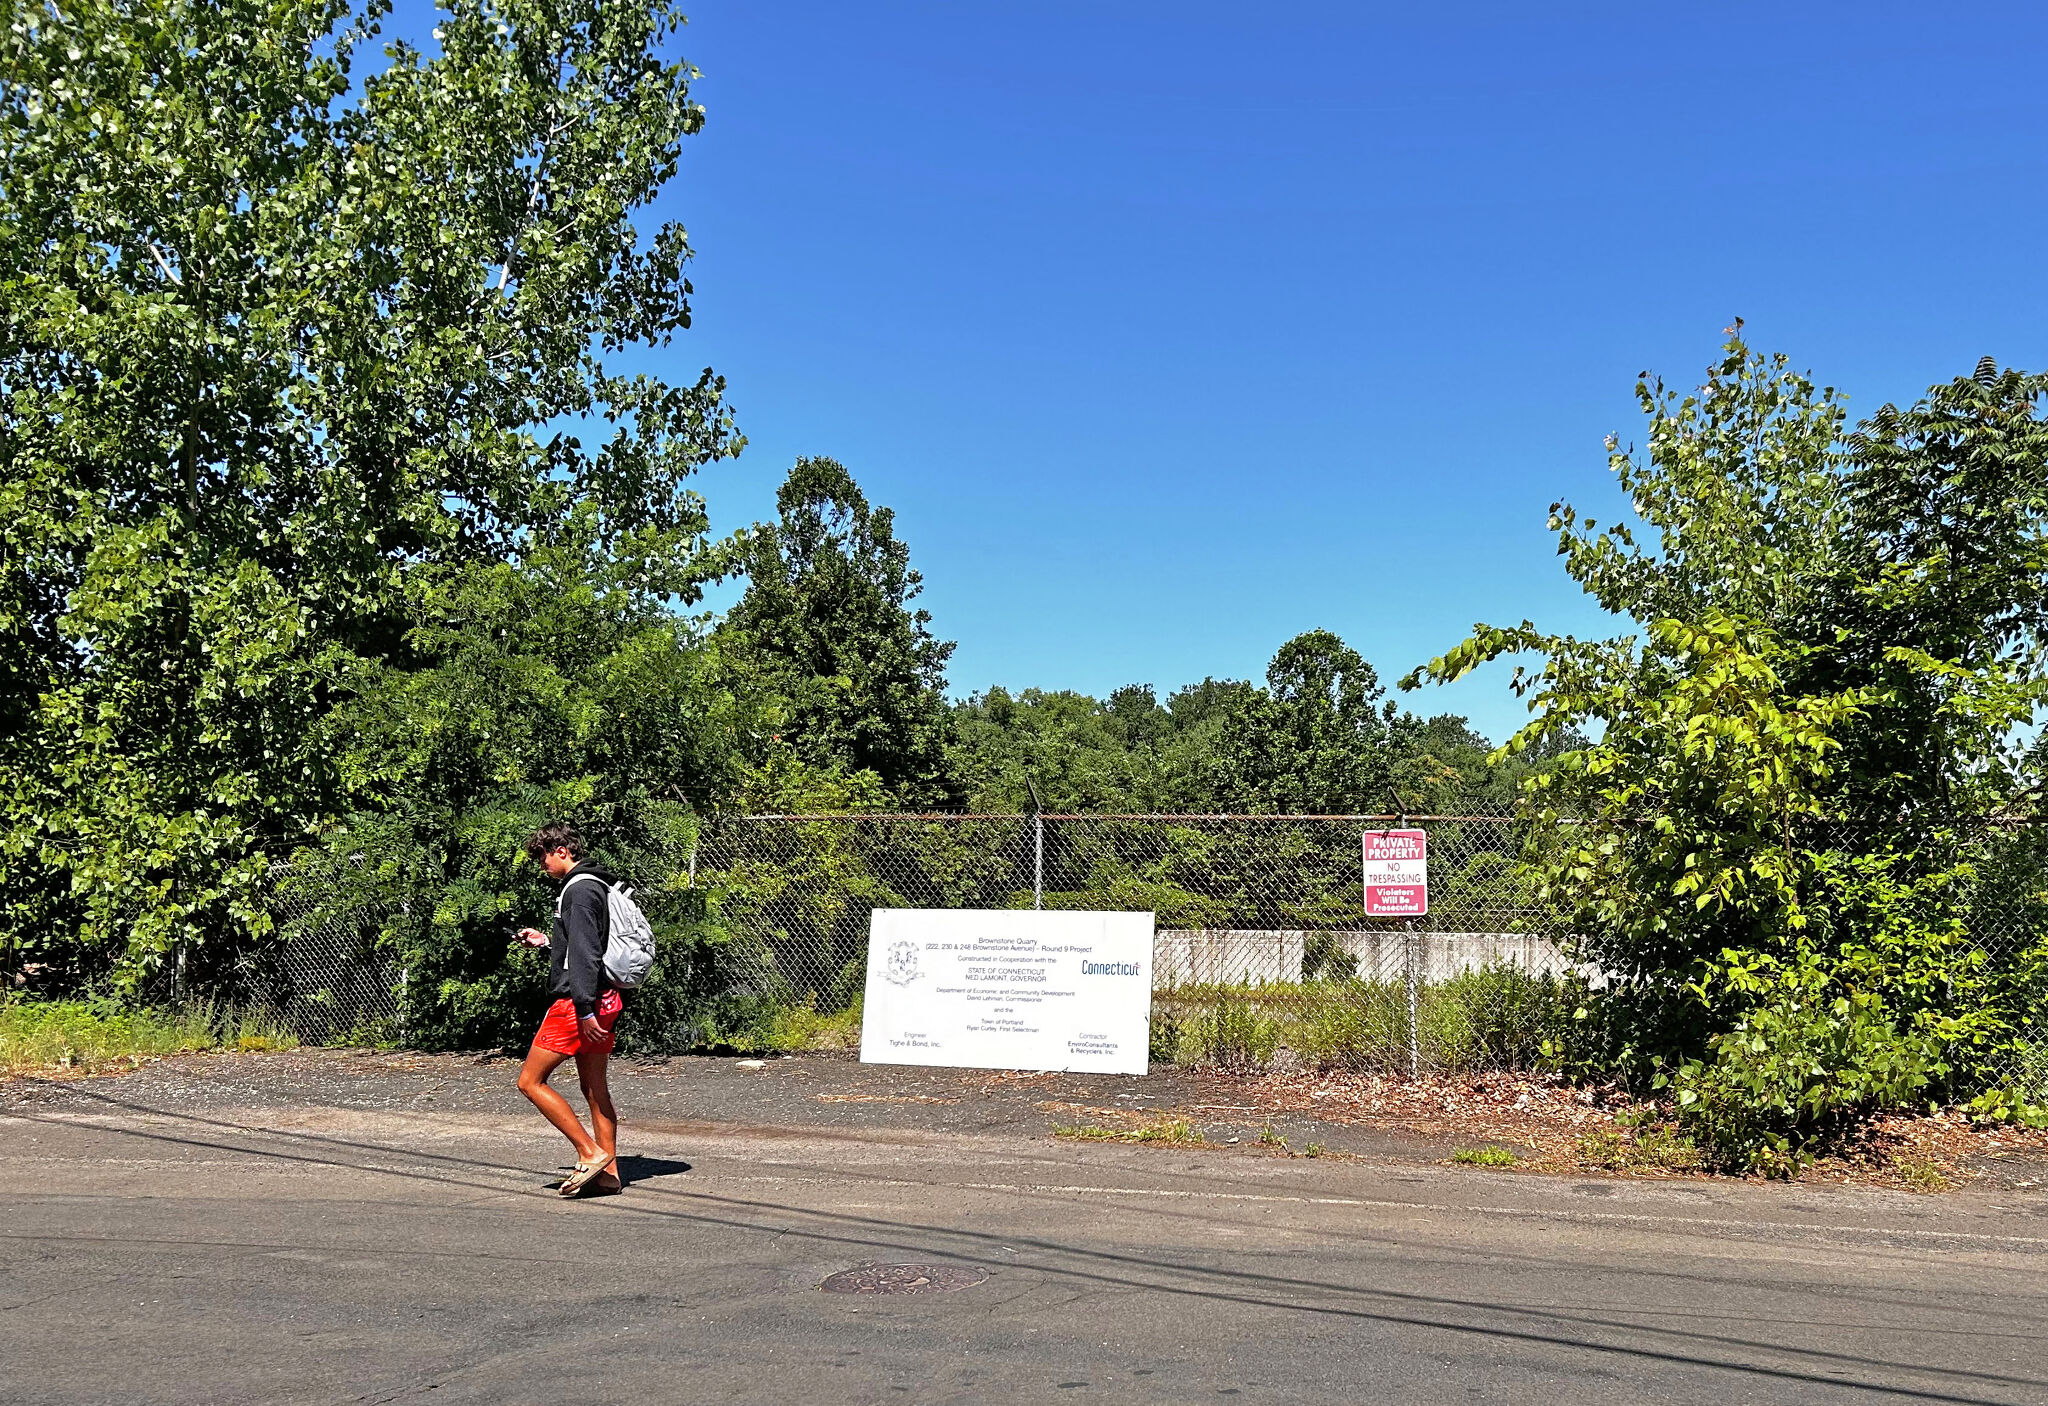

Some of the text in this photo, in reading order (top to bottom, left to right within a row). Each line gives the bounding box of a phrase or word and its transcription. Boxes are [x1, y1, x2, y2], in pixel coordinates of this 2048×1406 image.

[1373, 838, 1415, 848] PRIVATE
[1368, 848, 1420, 859] PROPERTY
[1388, 863, 1400, 871] NO
[1369, 874, 1421, 883] TRESPASSING
[1374, 903, 1418, 911] Prosecuted
[1070, 946, 1092, 954] Project
[1082, 959, 1140, 976] Connecticut
